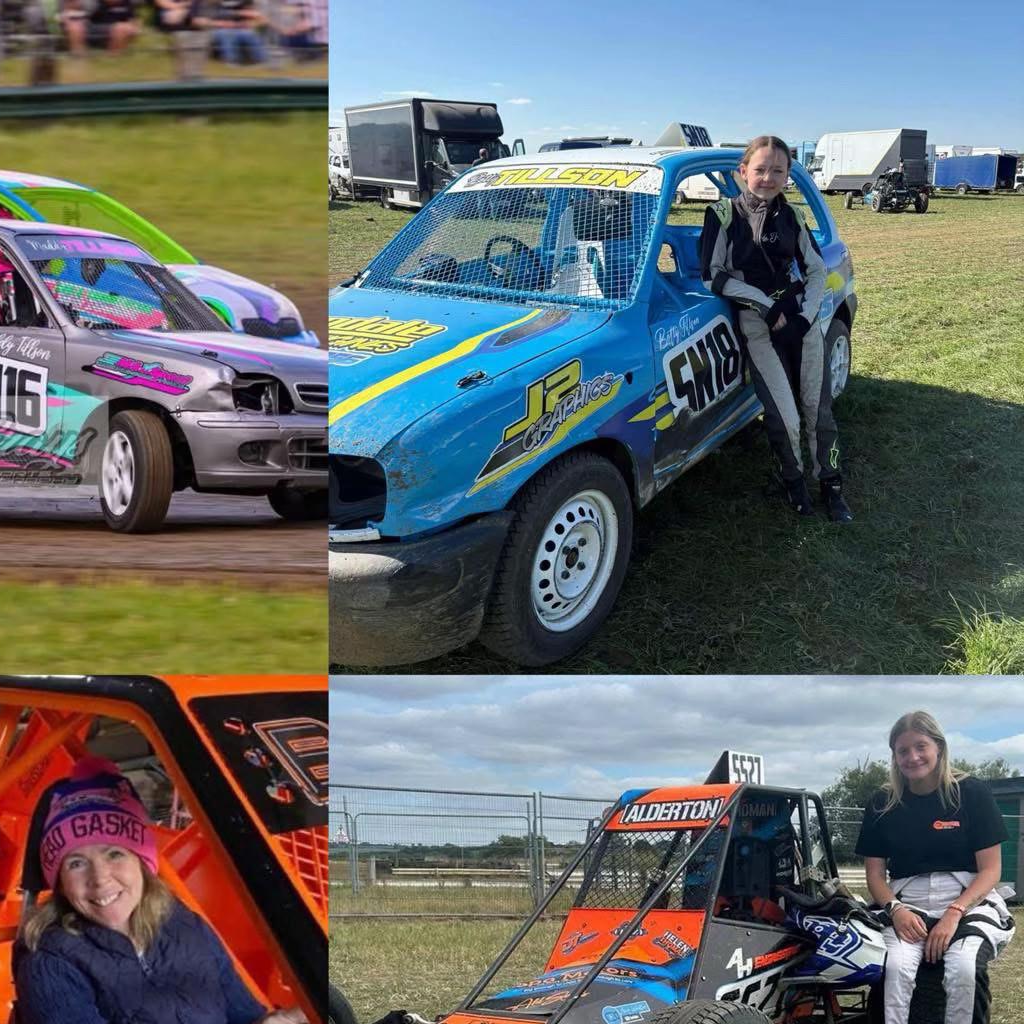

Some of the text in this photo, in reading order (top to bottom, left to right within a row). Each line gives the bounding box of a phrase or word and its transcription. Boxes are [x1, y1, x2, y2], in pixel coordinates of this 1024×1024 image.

[492, 168, 648, 187] TILLSON
[16, 336, 51, 360] Tillson
[669, 322, 740, 411] SN18
[504, 359, 581, 441] JP
[522, 371, 614, 451] GRAPHICS
[71, 813, 145, 846] GASKET
